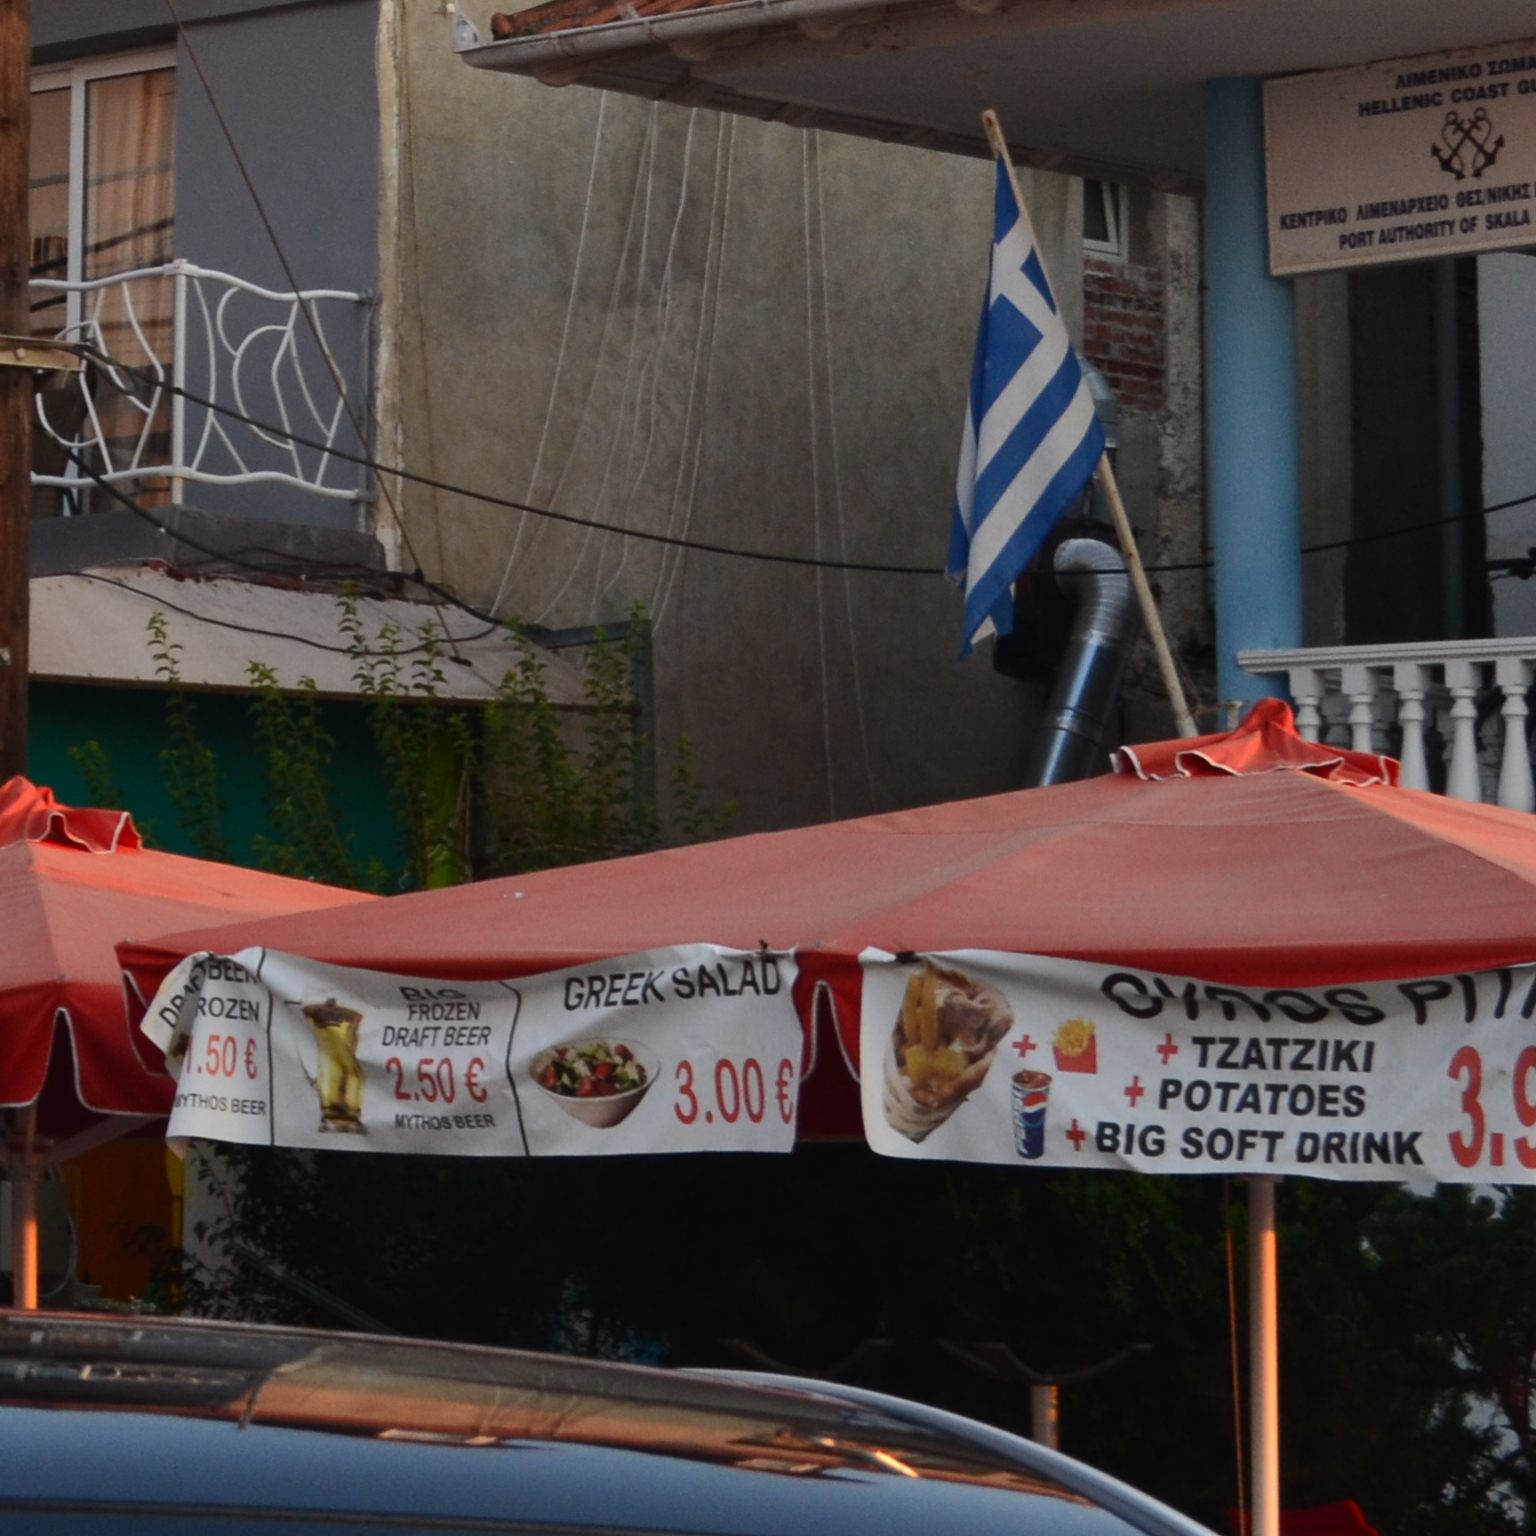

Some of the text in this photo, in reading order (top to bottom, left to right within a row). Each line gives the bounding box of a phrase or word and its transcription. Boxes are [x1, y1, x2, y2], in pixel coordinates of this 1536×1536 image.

[1395, 63, 1482, 90] ΛΙΜΕΝΙΚΟ
[1358, 92, 1443, 118] HELLENIC
[1451, 82, 1509, 104] COAST
[1280, 207, 1347, 231] ΚΕΝΤΡΙΚΟ
[1356, 194, 1449, 221] ΛΙΜΕΝΑΡΧΕΙΟ
[1340, 210, 1530, 250] PORT AUTHORITY OF SKALA
[399, 986, 466, 1001] BIG
[563, 960, 783, 1012] GREEK SALAD
[197, 997, 260, 1022] ROZEN
[408, 1002, 480, 1021] FROZEN
[382, 1025, 492, 1047] DRAFT BEER
[1191, 1035, 1376, 1074] TZATZIKI
[386, 1057, 455, 1103] 2.50
[673, 1057, 767, 1127] 3.00
[1158, 1078, 1366, 1118] POTATOES
[231, 1098, 266, 1115] BEER
[394, 1114, 496, 1130] MYTHOS BEER
[1095, 1121, 1425, 1165] BIG SOFT DRINK
